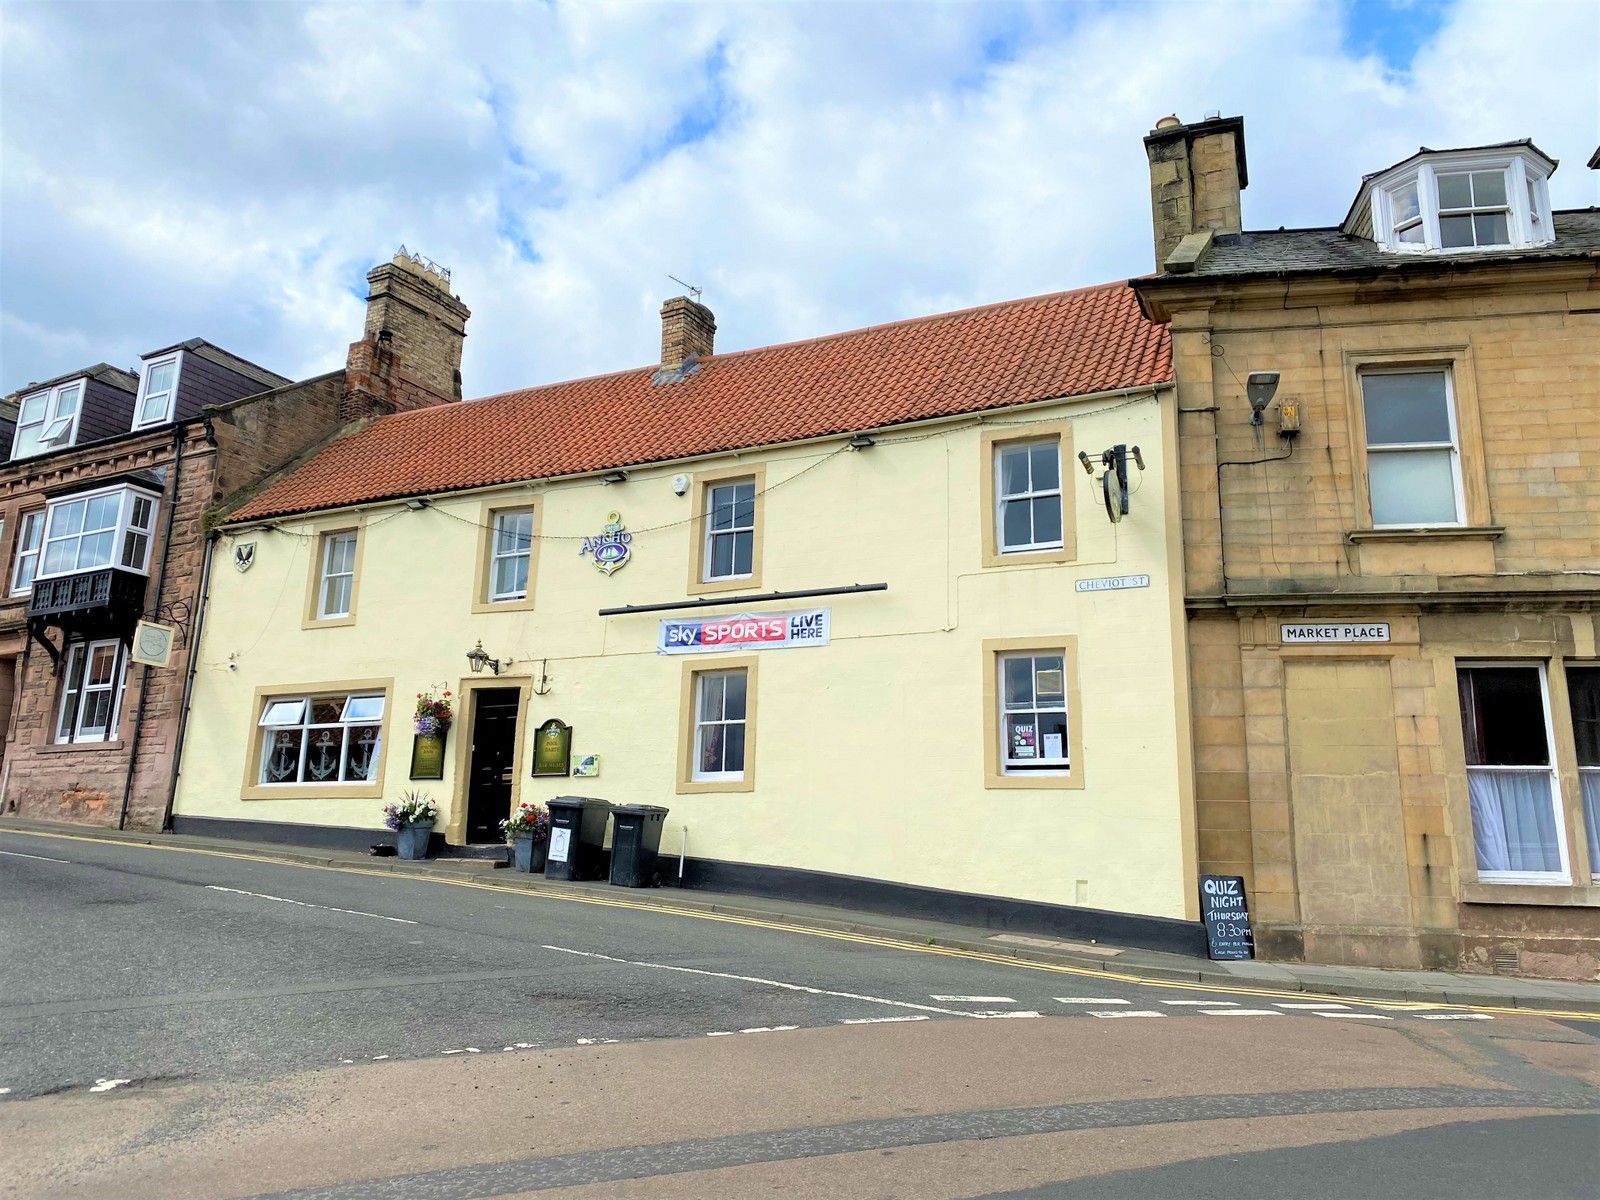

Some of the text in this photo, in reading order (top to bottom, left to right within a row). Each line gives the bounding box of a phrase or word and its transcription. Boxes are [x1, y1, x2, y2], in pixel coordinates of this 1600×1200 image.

[1079, 577, 1145, 590] CHEVIOT ST
[791, 614, 823, 628] LIVE
[669, 621, 783, 645] sky SPORTS
[790, 627, 823, 640] HERE
[1287, 627, 1385, 638] MARKET PLACE
[1015, 725, 1033, 735] QUIZ
[1204, 880, 1238, 895] QUIZ
[1211, 896, 1243, 908] NIGHT
[1207, 910, 1248, 921] THURSDAY
